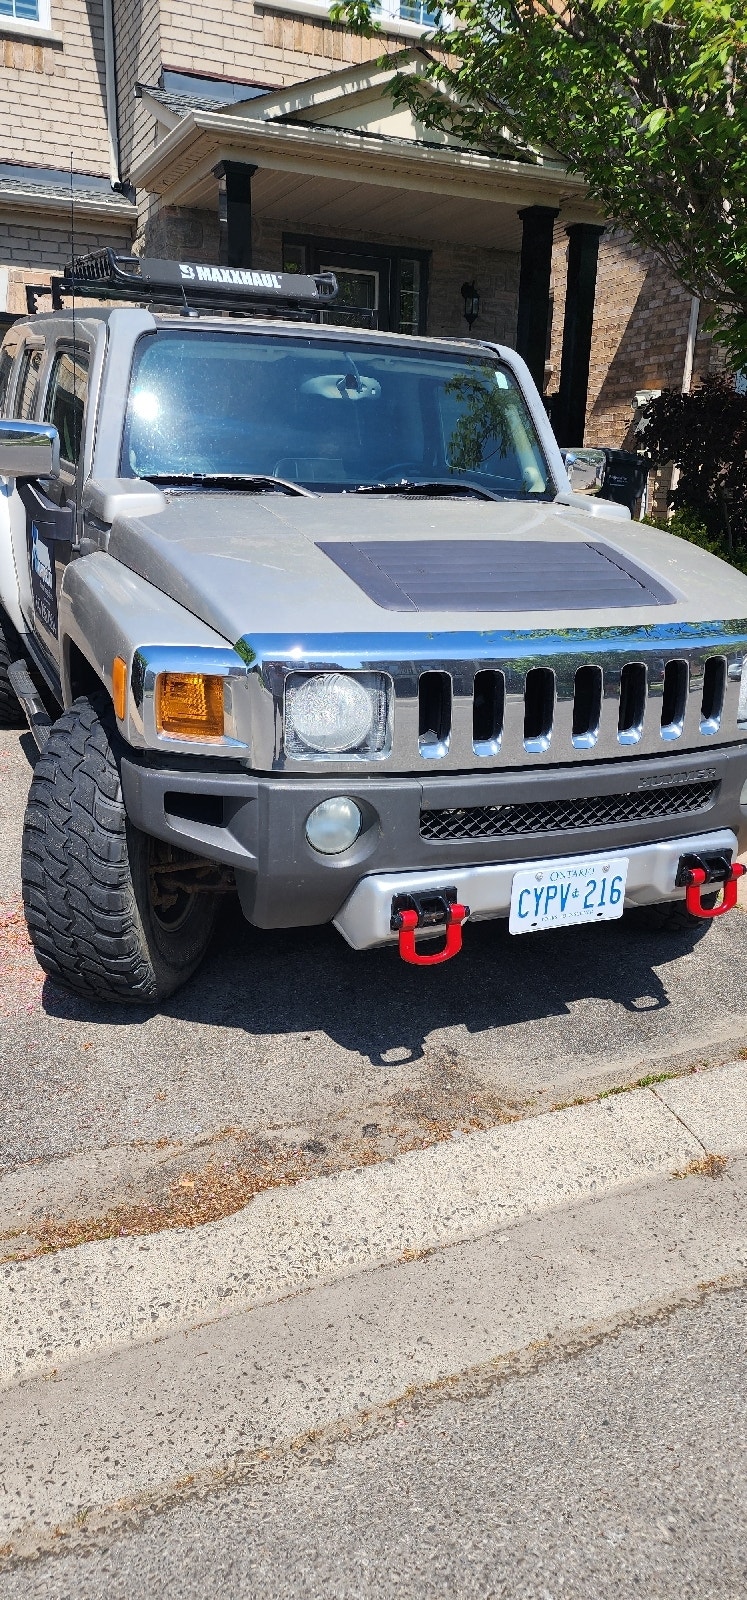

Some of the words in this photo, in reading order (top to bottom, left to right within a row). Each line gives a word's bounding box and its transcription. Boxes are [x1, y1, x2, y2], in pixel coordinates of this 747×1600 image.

[195, 265, 281, 289] MAXXHAUL
[638, 768, 716, 788] HUMMER
[549, 867, 595, 881] ONTARIO
[518, 882, 571, 918] CYPV
[583, 875, 622, 909] 216
